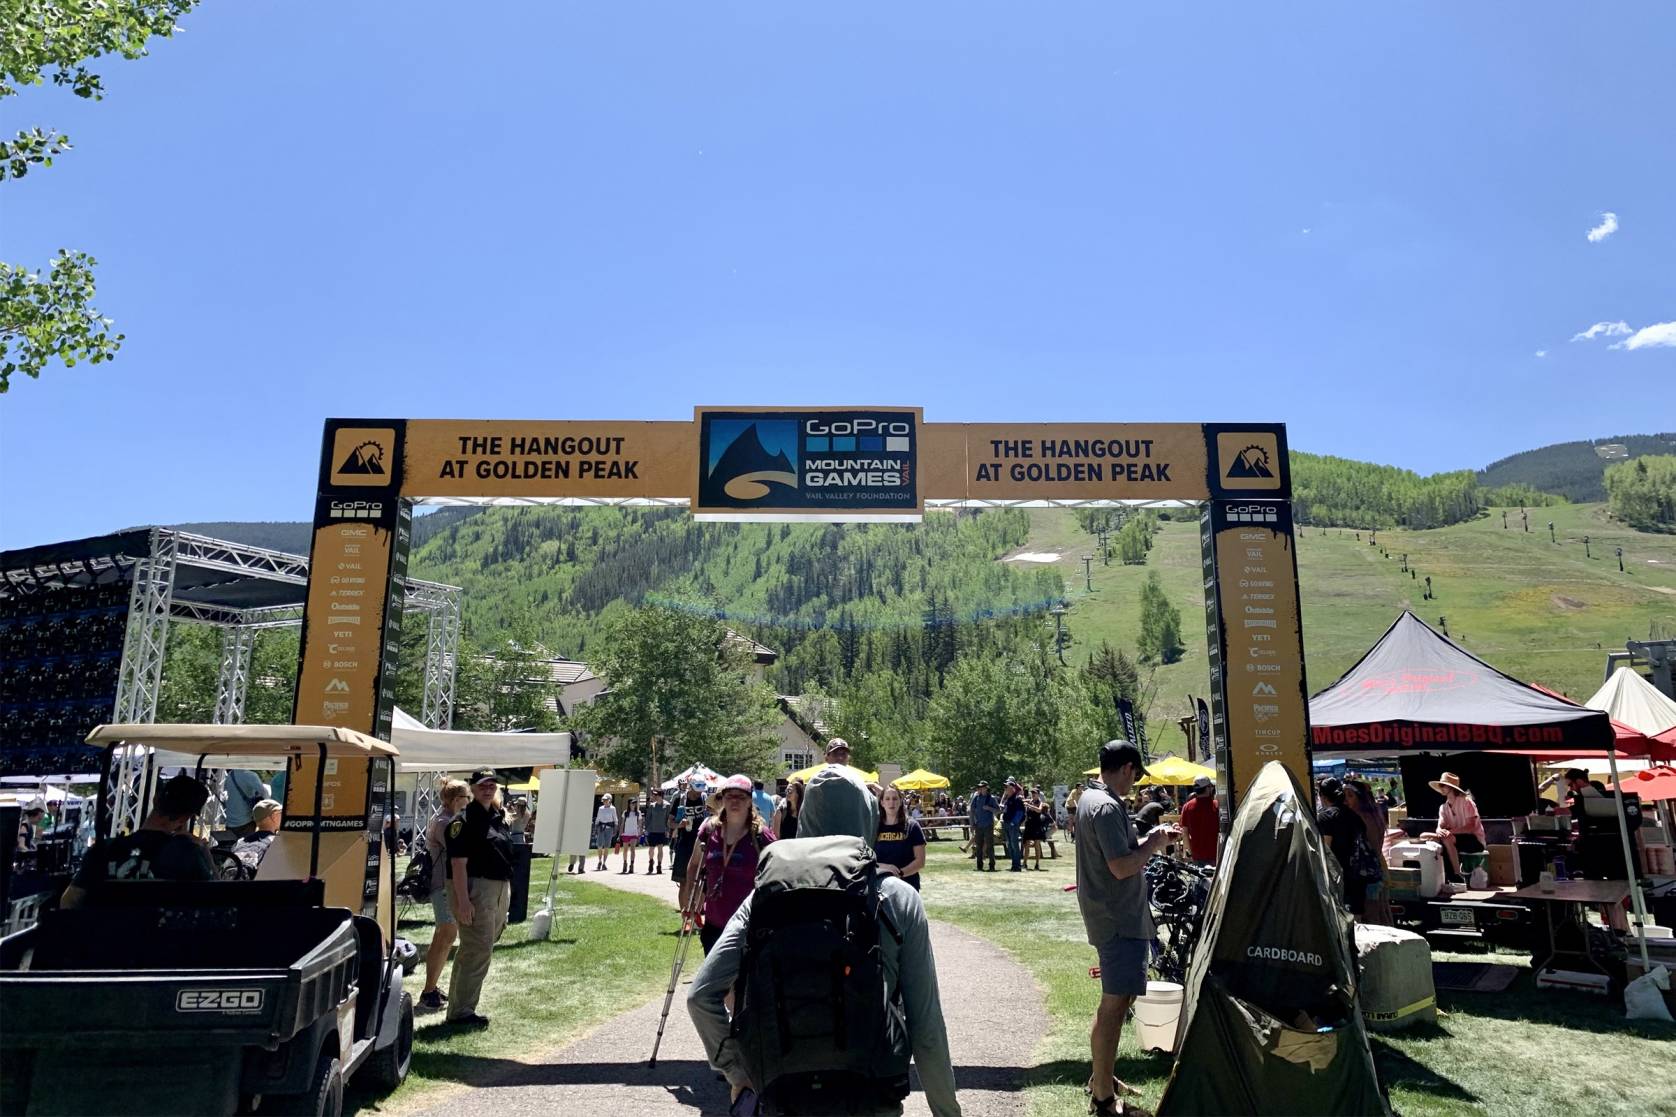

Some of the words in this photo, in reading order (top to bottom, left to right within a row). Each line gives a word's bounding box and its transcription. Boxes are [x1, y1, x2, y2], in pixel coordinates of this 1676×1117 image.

[806, 419, 909, 435] GoPro
[458, 436, 502, 456] THE
[510, 436, 625, 456] HANGOUT
[990, 439, 1033, 458] THE
[1041, 439, 1154, 458] HANGOUT
[439, 460, 468, 479] AT
[476, 460, 570, 480] GOLDEN
[578, 460, 639, 480] PEAK
[805, 459, 901, 470] MOUNTAIN
[902, 460, 910, 486] VAIL
[975, 463, 1003, 482] AT
[1010, 463, 1103, 482] GOLDEN
[1111, 463, 1172, 482] PEAK
[805, 471, 901, 487] GAMES
[331, 501, 383, 510] GoPro
[806, 492, 822, 500] VAIL
[825, 492, 854, 500] VALLEY
[856, 492, 910, 500] FOUNDATION
[1225, 505, 1277, 514] GoPro
[1312, 722, 1564, 746] MoesOriginalBBQ.com
[1247, 946, 1323, 967] CARDBOARD
[180, 991, 261, 1010] EZGO
